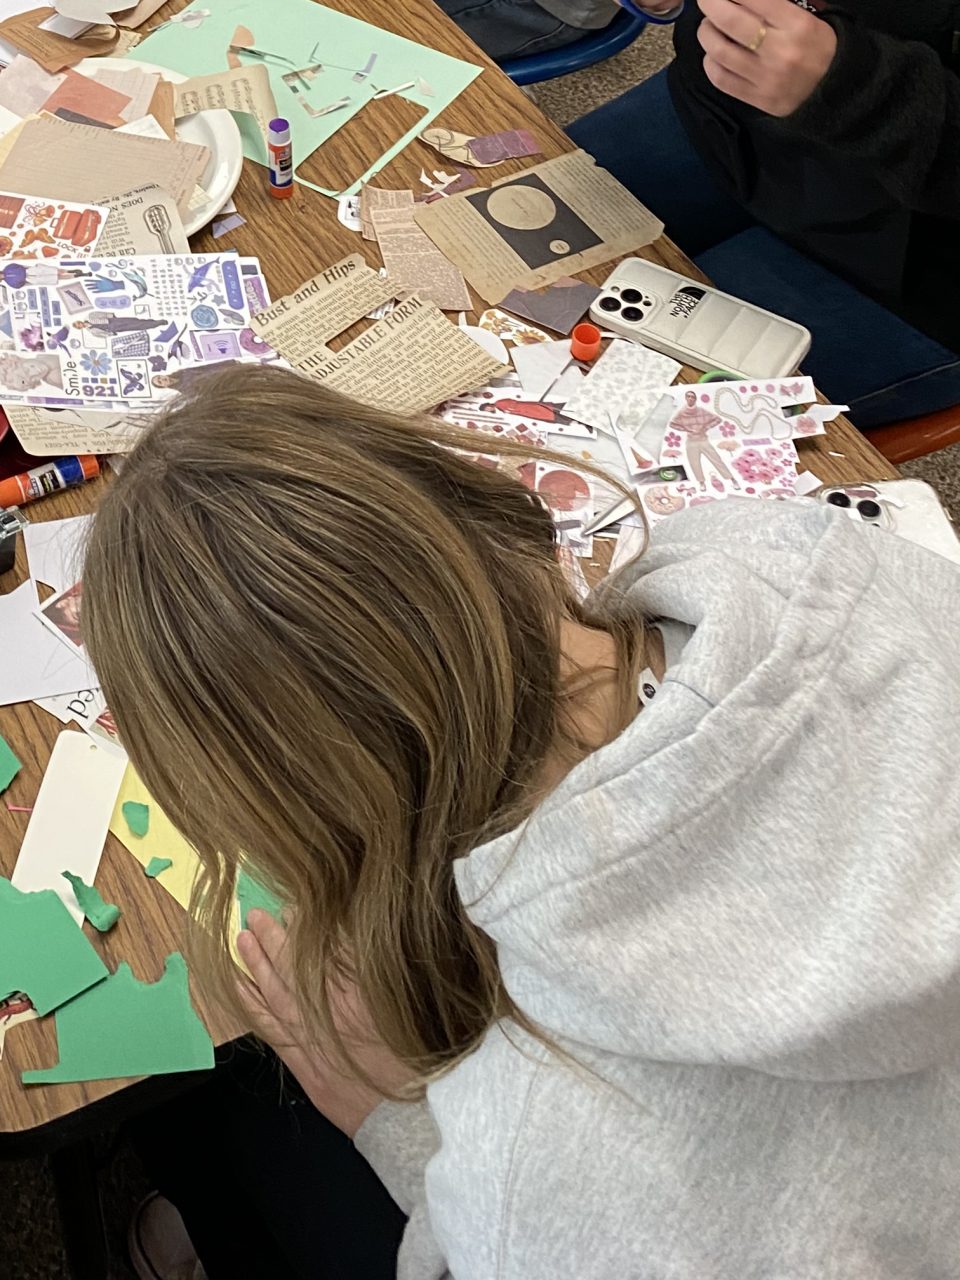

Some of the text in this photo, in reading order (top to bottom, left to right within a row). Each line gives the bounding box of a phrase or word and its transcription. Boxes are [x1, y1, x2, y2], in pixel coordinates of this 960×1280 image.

[255, 299, 291, 327] Bust
[295, 282, 321, 306] and
[323, 259, 357, 285] Hips
[310, 297, 424, 382] ADJUSTABLE FORM
[64, 361, 81, 396] Smile
[297, 351, 327, 372] THE
[82, 385, 119, 398] 921
